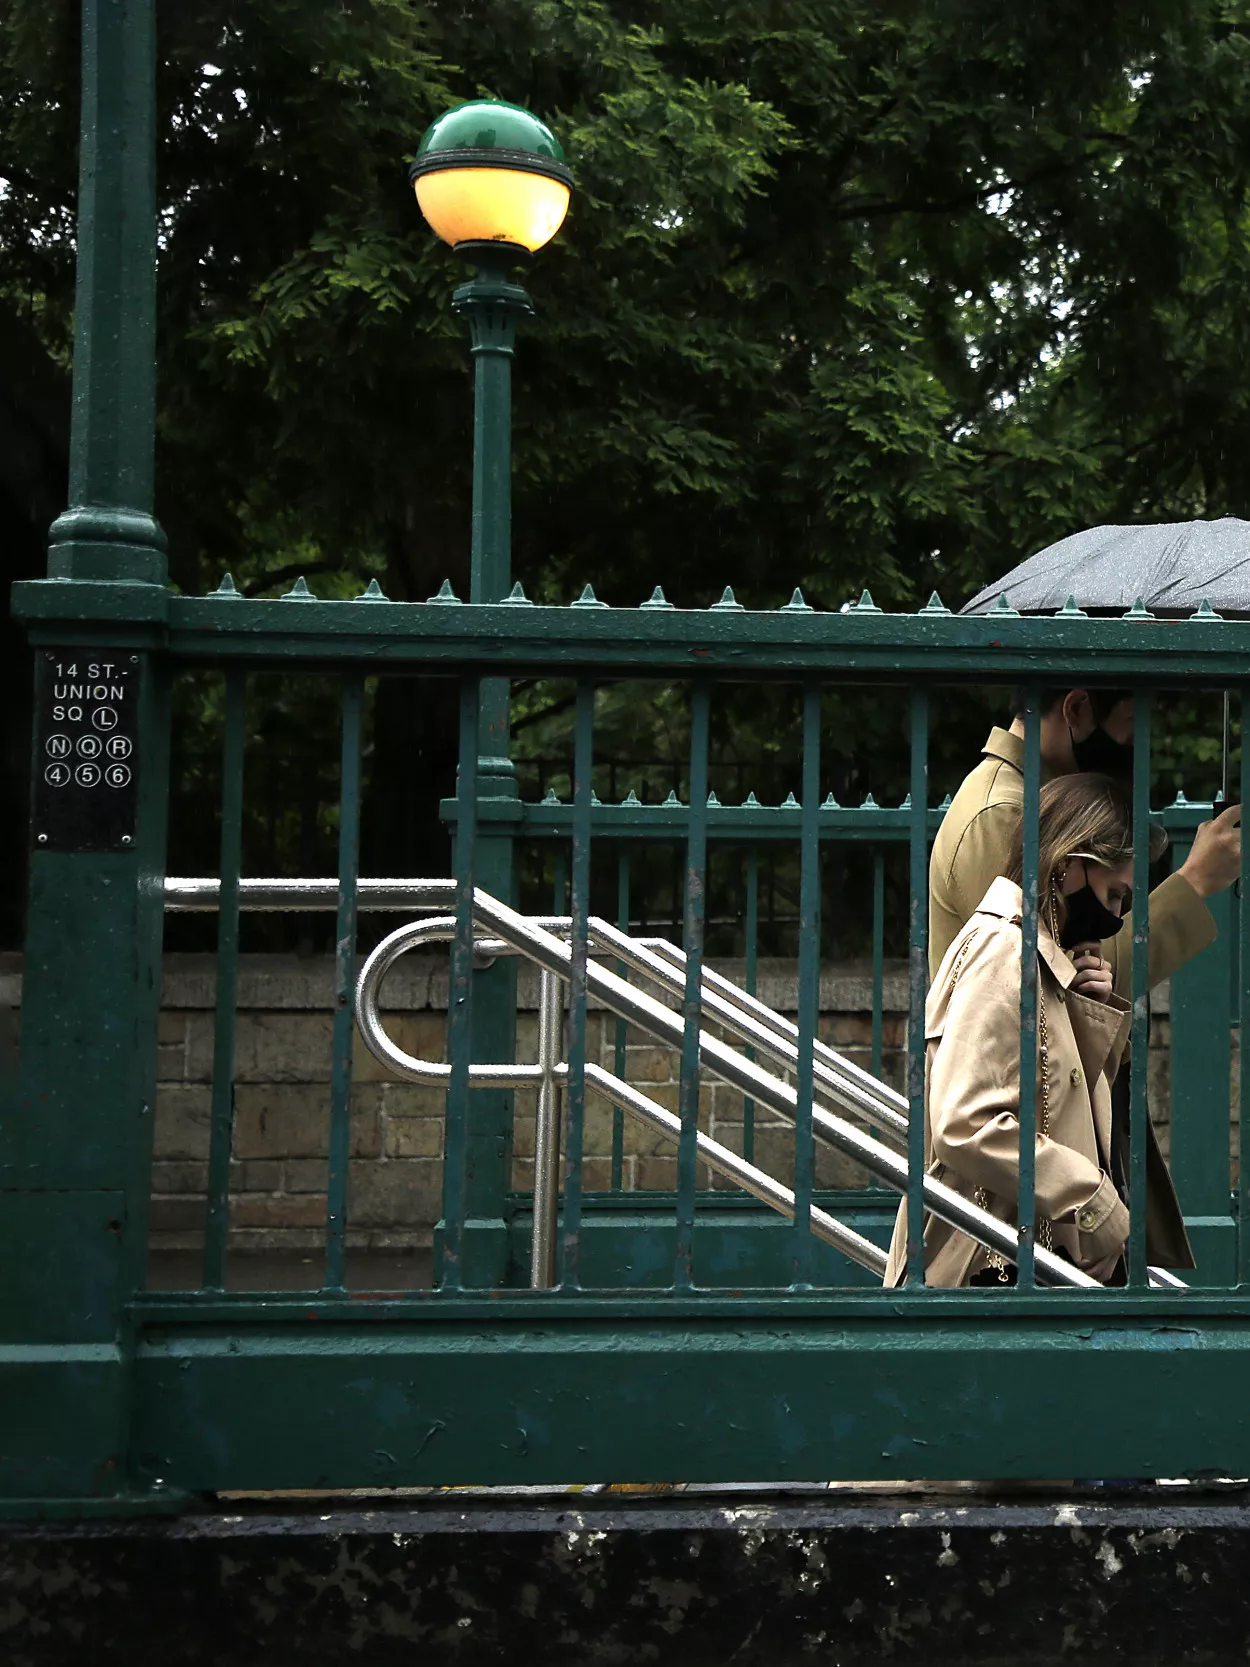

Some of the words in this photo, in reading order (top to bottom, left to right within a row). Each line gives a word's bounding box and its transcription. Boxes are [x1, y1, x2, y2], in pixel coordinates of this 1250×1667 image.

[55, 663, 78, 678] 14
[54, 684, 124, 700] UNION
[53, 706, 83, 722] SQ
[100, 710, 112, 726] L
[52, 739, 66, 753] N
[80, 739, 96, 754] Q
[112, 740, 126, 755] R
[50, 768, 62, 782] 4
[82, 768, 93, 782] 5
[112, 769, 124, 783] 6
